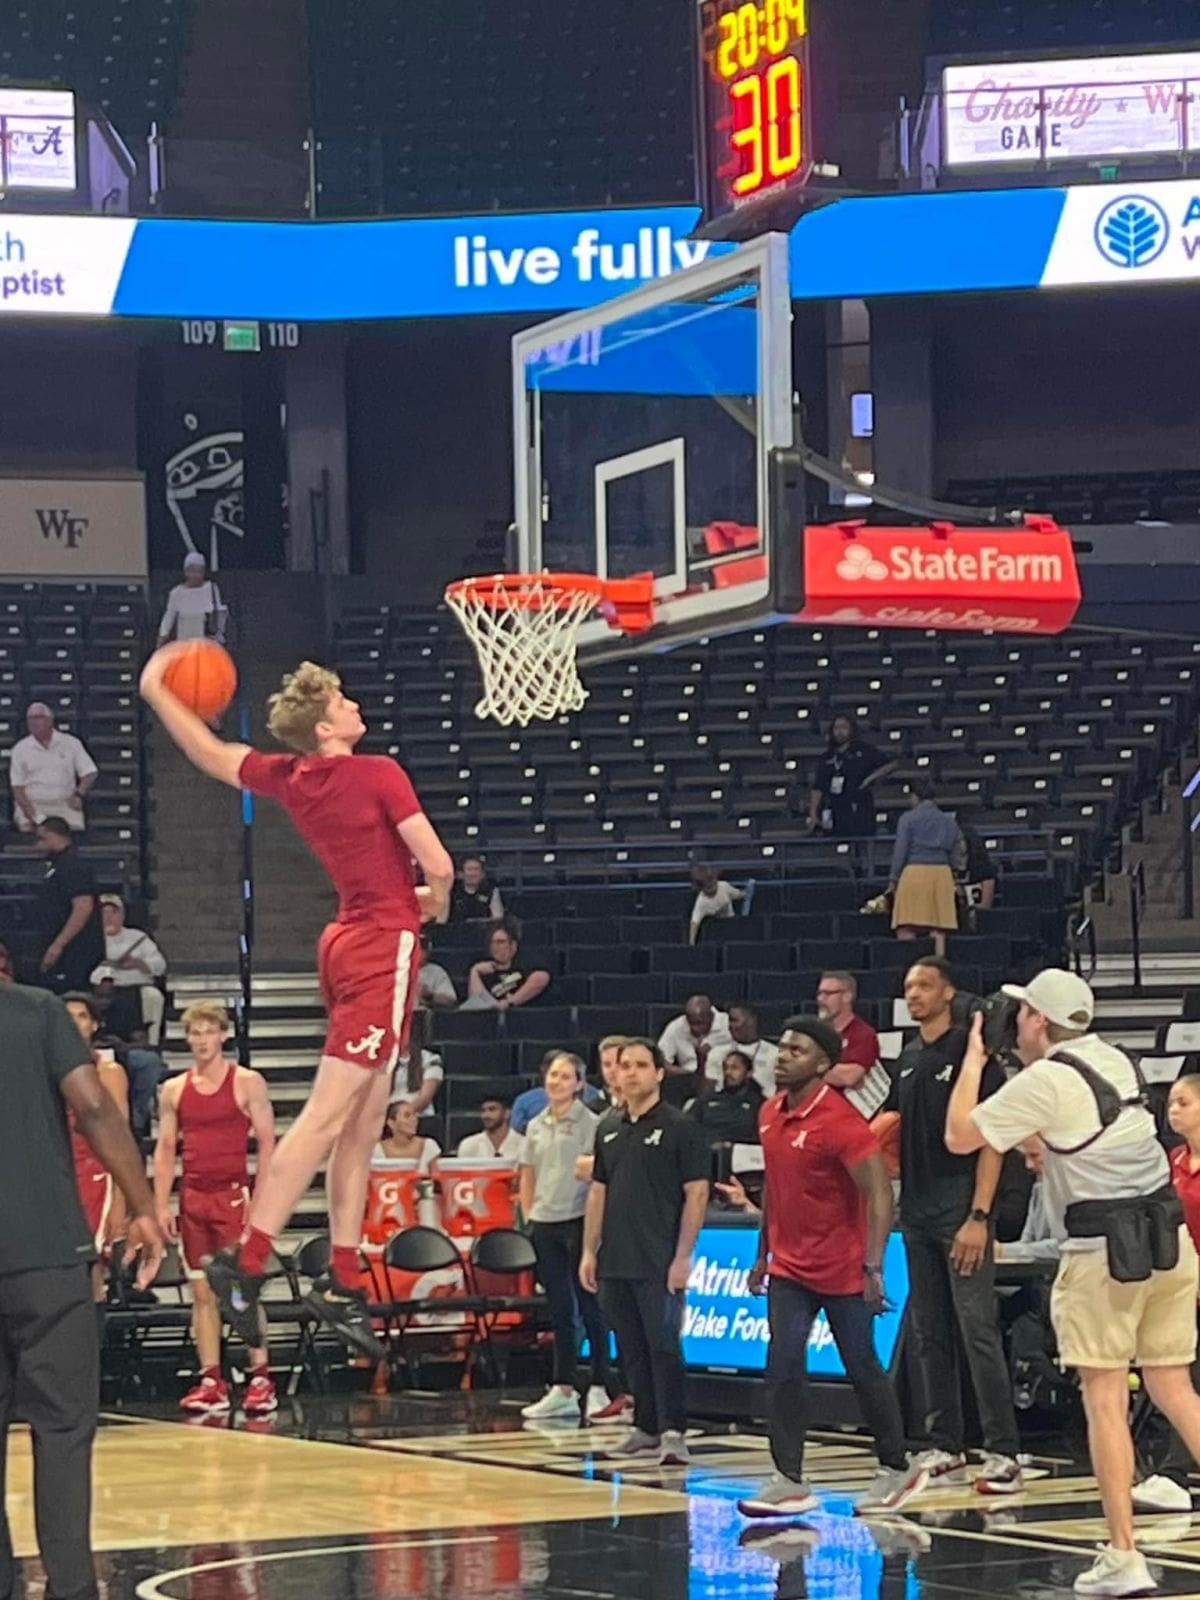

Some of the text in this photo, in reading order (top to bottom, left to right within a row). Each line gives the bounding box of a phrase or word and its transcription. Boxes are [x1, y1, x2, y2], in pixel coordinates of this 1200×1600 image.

[964, 79, 1101, 130] Chaity
[731, 55, 801, 196] 30
[454, 234, 560, 287] live
[3, 269, 65, 299] ptist
[182, 320, 298, 346] 109 110
[35, 509, 89, 548] WF
[379, 1181, 399, 1205] G
[454, 1180, 475, 1205] G
[686, 1256, 770, 1298] Atriu
